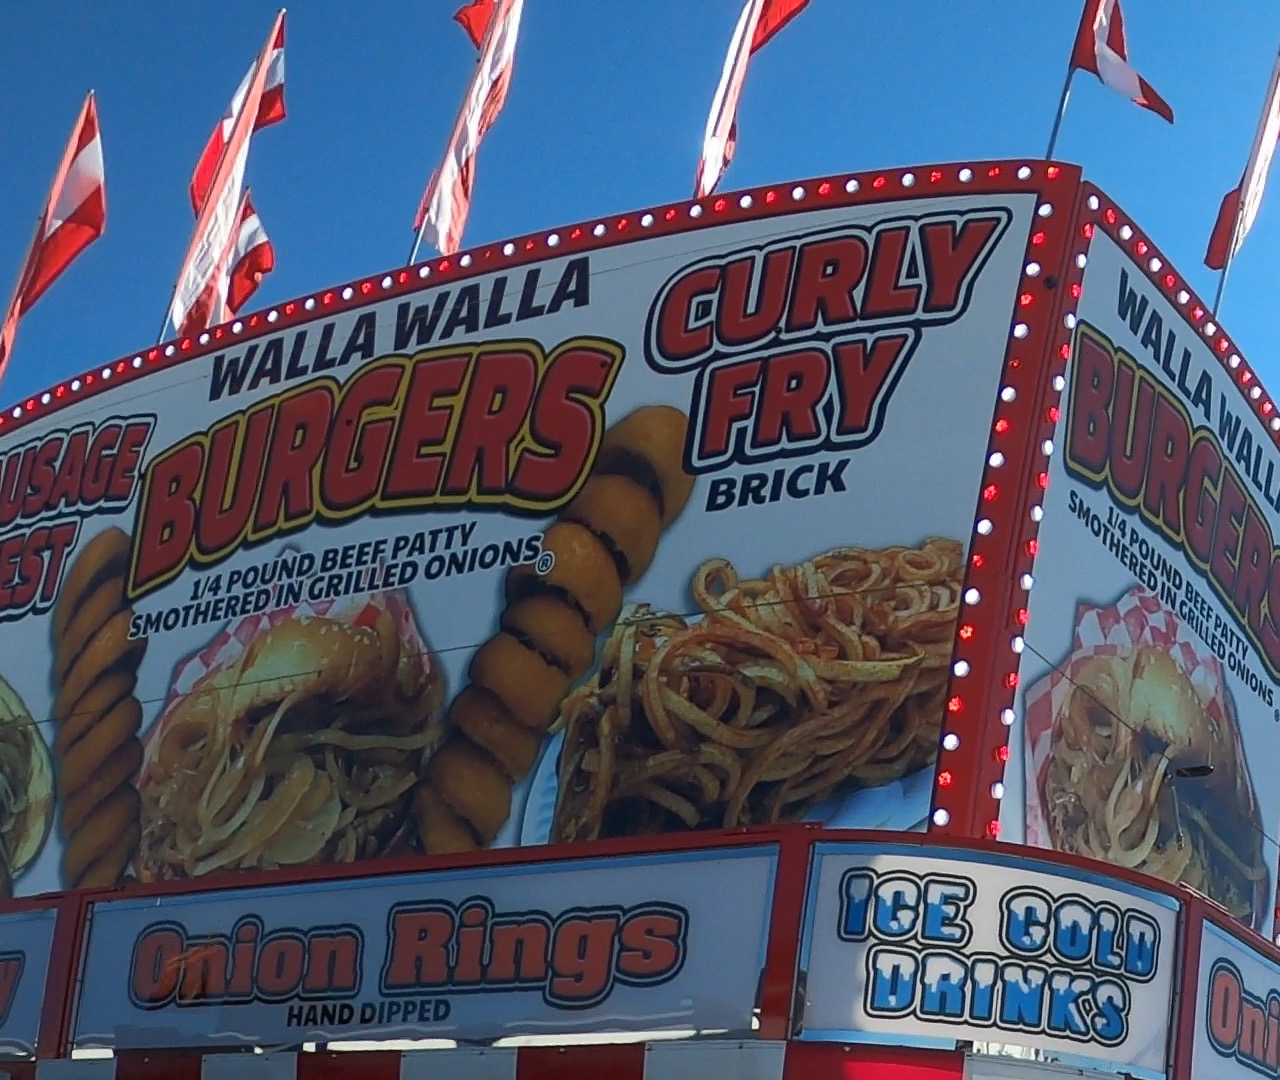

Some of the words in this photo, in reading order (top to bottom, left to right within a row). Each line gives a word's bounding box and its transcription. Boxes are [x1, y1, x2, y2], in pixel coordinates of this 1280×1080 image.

[209, 311, 376, 400] WALLA
[394, 257, 590, 351] WALLA
[645, 206, 1012, 374] CURLY
[1117, 268, 1213, 423] WALLA
[684, 327, 922, 475] FRY
[0, 413, 157, 533] USAGE
[128, 337, 624, 598] BURGERS
[705, 459, 850, 512] BRICK
[128, 588, 271, 639] SMOTHERED
[275, 582, 301, 607] IN
[308, 560, 419, 600] GRILLED
[424, 534, 544, 580] ONIONS
[191, 577, 222, 600] 1/4
[226, 553, 315, 592] POUND
[320, 539, 388, 572] BEEF
[396, 522, 477, 560] PATTY
[1068, 490, 1158, 592] SMOTHERED
[1160, 584, 1177, 612] IN
[1179, 600, 1225, 661] GRILLED
[1228, 652, 1274, 707] ONIONS
[1107, 506, 1127, 538] 1/4
[1129, 527, 1182, 590] POUND
[1186, 580, 1213, 622] BEEF
[1215, 612, 1248, 659] PATTY
[129, 914, 364, 1008] Onion
[380, 895, 689, 1009] Rings
[837, 867, 975, 945] ICE
[999, 885, 1160, 983] COLD
[286, 1001, 354, 1028] HAND
[359, 1000, 450, 1024] DIPPED
[865, 945, 1130, 1046] DRINKS
